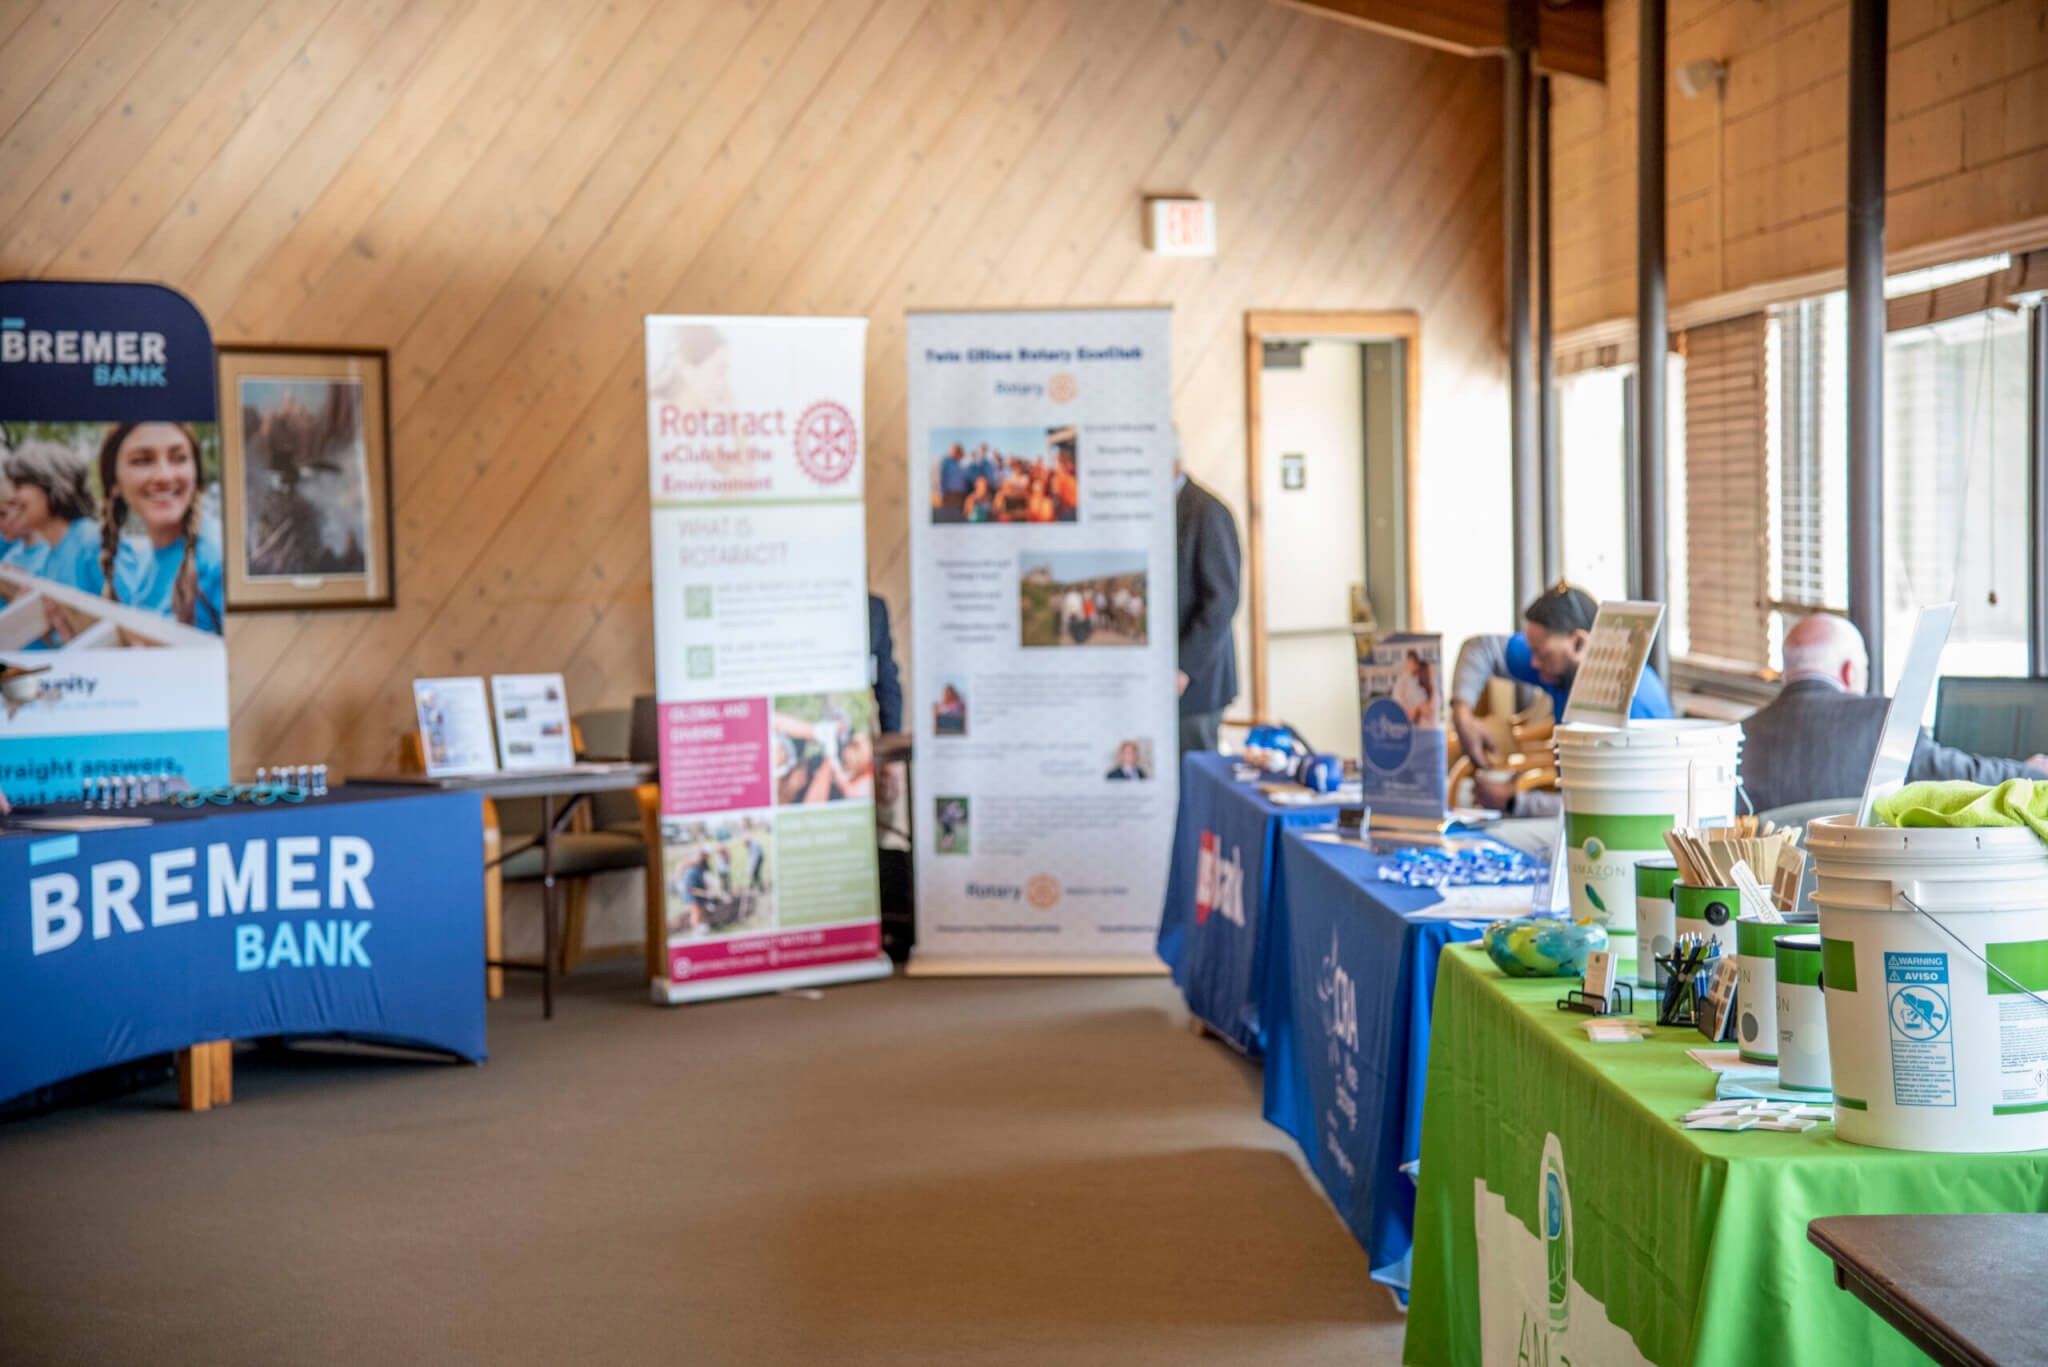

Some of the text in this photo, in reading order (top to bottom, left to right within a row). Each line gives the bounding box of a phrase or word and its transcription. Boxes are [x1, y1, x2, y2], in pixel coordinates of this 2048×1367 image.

[1, 331, 167, 364] BREMER
[1018, 347, 1072, 363] Rotary
[93, 365, 167, 387] BANK
[659, 403, 787, 438] Rotaract
[29, 836, 375, 956] BREMER
[235, 920, 371, 972] BANK
[1898, 957, 1943, 966] WARNING
[1904, 972, 1939, 980] AVISO
